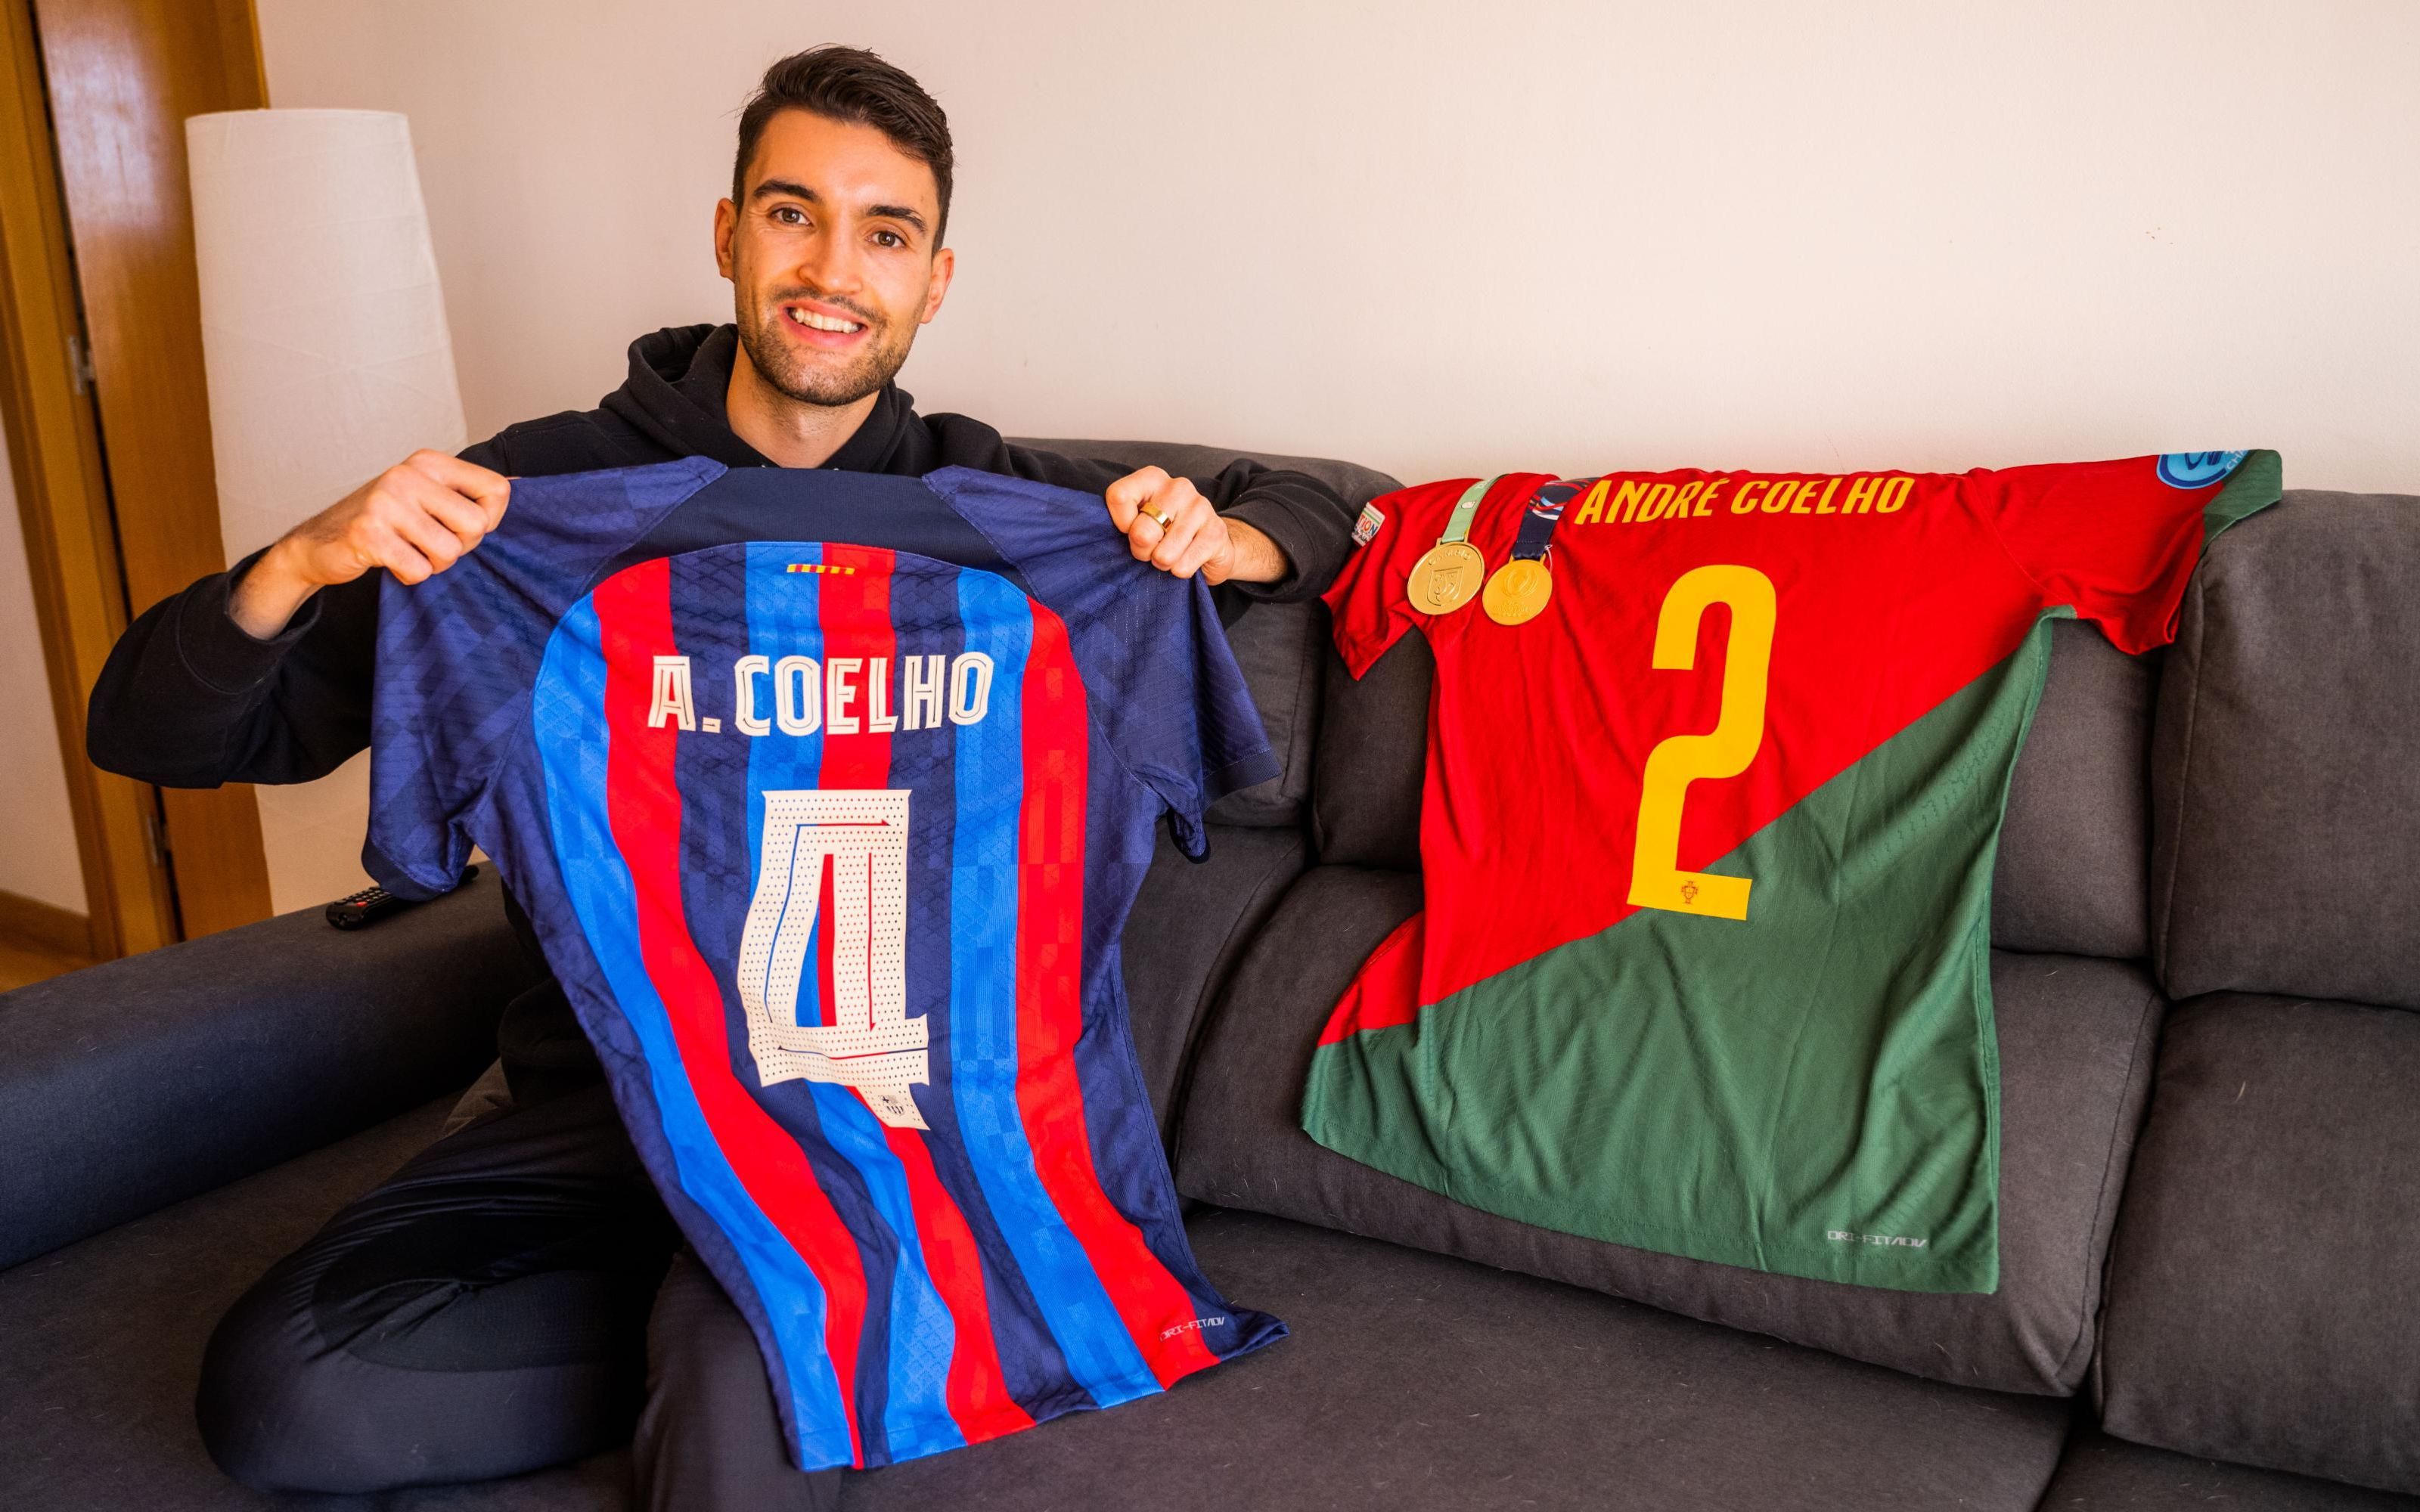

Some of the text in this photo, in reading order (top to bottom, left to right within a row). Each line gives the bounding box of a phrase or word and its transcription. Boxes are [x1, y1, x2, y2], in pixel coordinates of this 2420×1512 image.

[1574, 476, 1916, 525] ANDRÉ COELHO
[1627, 564, 1776, 921] 2
[737, 789, 930, 1130] 4
